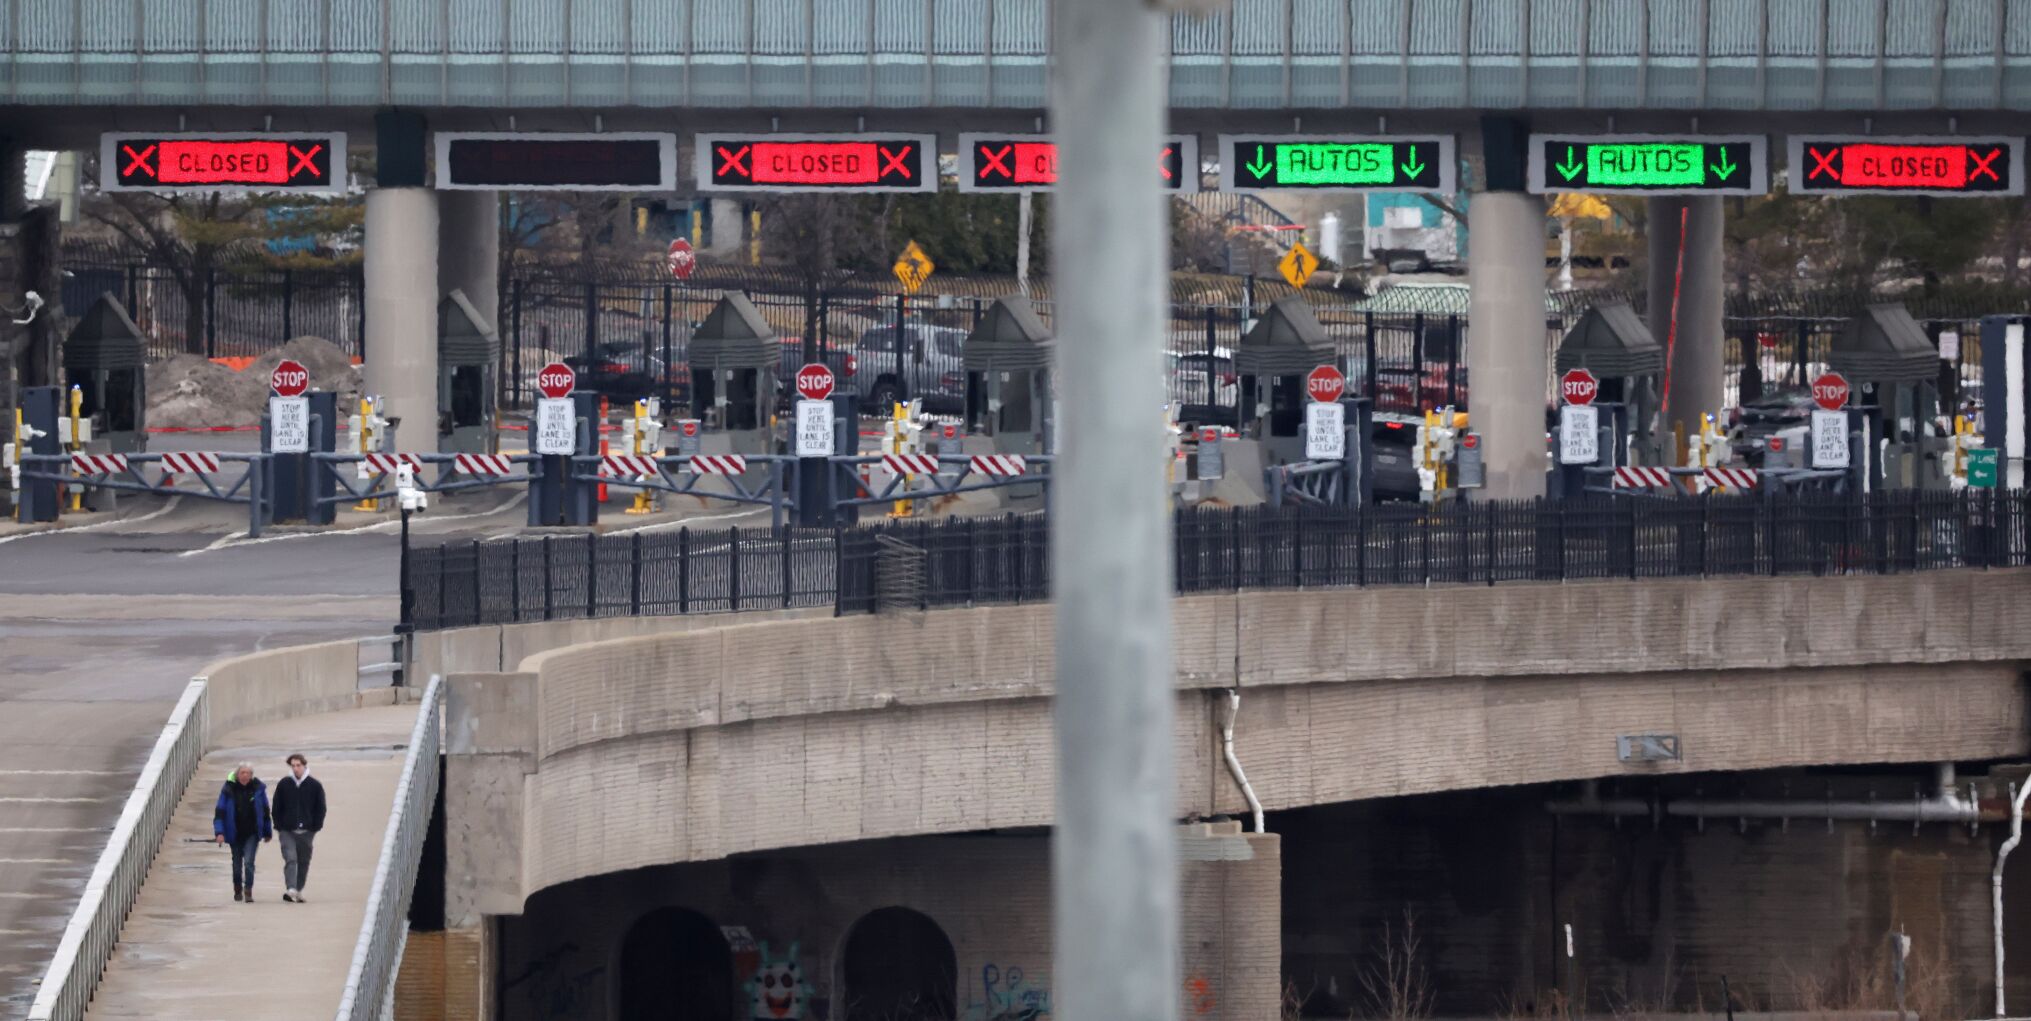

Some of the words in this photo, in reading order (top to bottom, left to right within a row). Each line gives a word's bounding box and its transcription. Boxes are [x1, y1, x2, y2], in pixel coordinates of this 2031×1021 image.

[178, 153, 270, 173] CLOSED
[772, 154, 860, 174] CLOSED
[1290, 149, 1380, 172] AUTOS
[1600, 149, 1691, 173] AUTOS
[1862, 156, 1949, 178] CLOSED
[273, 372, 306, 388] STOP
[540, 373, 572, 388] STOP
[800, 375, 832, 390] STOP
[1310, 378, 1342, 392] STOP
[1564, 381, 1594, 396] STOP
[1814, 385, 1846, 399] STOP
[547, 422, 567, 430] UNTIL
[540, 430, 560, 438] LANE
[280, 438, 302, 446] CLEAR
[545, 439, 569, 448] CLEAR
[805, 441, 826, 449] CLEAR
